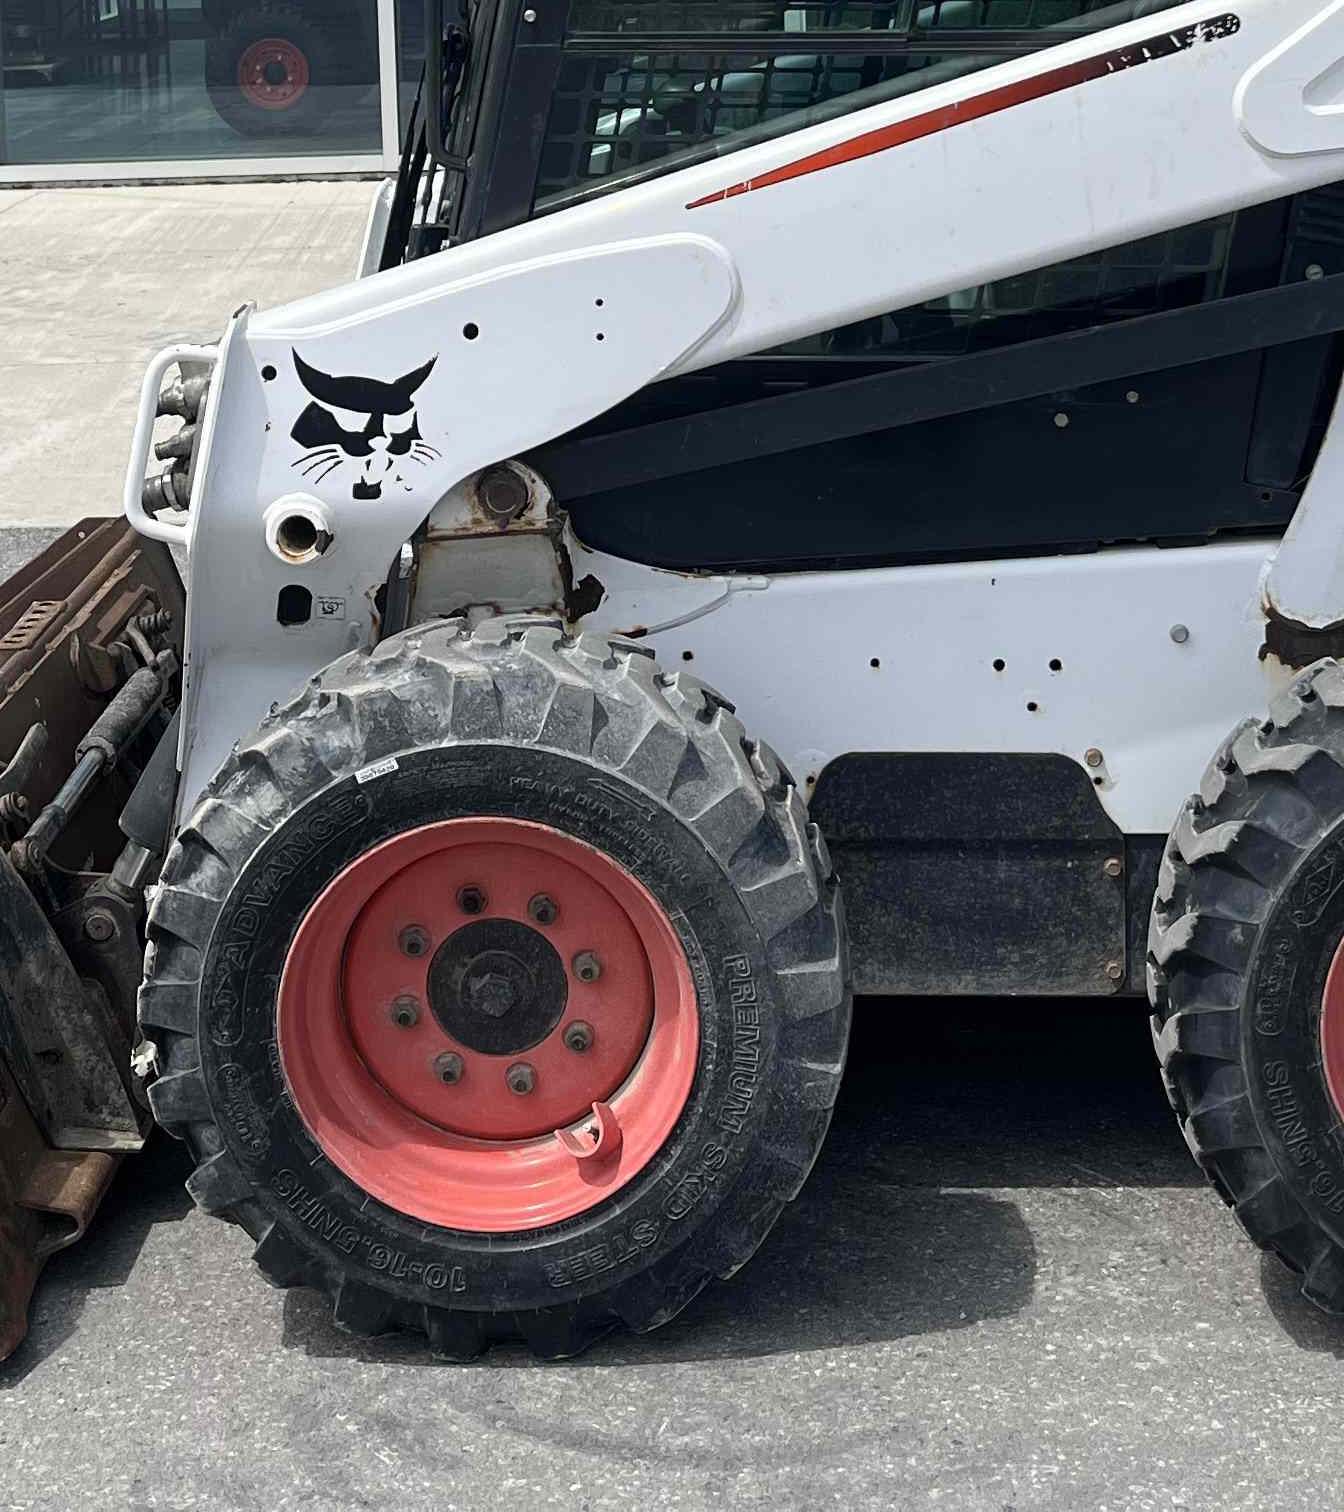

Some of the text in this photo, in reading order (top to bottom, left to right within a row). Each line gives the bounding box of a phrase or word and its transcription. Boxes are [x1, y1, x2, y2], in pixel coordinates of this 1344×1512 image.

[222, 790, 356, 971] ADVANCE
[718, 953, 760, 1135] PREMIUM
[271, 1168, 467, 1293] 10-16.5NHS
[662, 1142, 729, 1222] SKID
[544, 1217, 658, 1288] STEER
